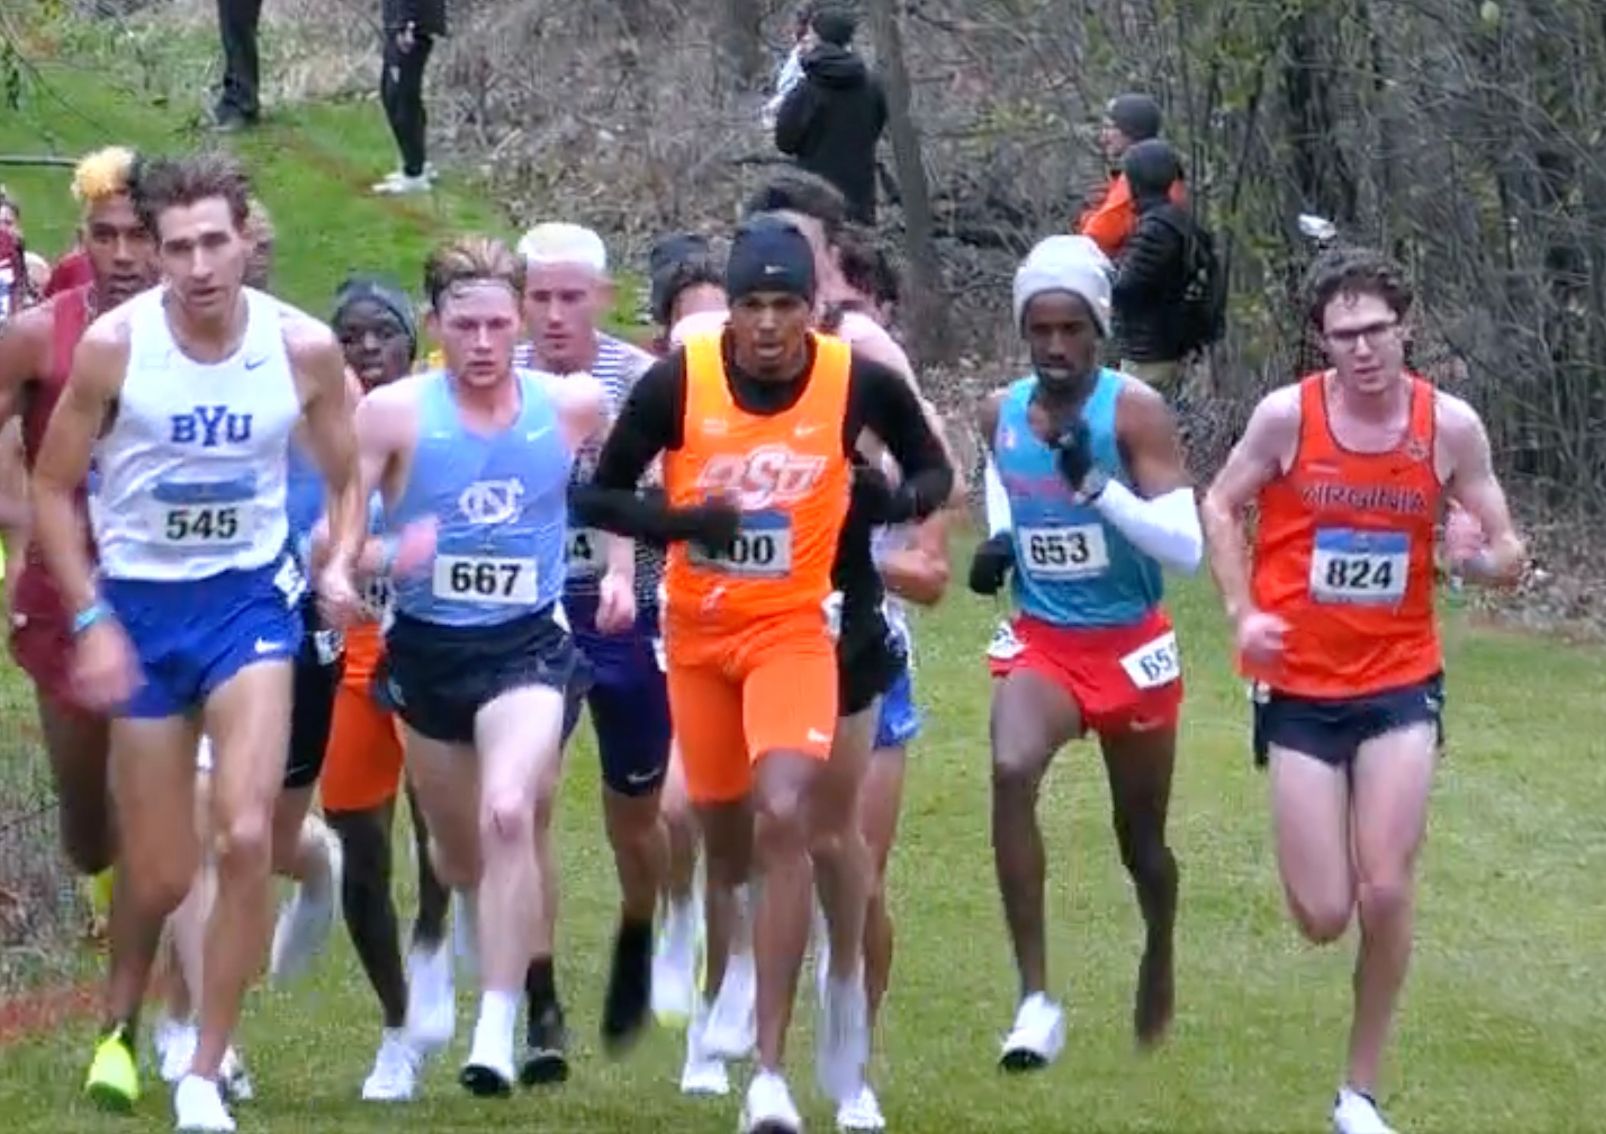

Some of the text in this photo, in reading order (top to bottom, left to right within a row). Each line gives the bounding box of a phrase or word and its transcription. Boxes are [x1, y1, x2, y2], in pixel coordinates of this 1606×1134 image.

[170, 405, 252, 446] BYU
[165, 508, 238, 540] 545
[708, 535, 775, 564] 00
[1030, 532, 1089, 564] 653
[451, 561, 523, 596] 667
[1325, 558, 1393, 589] 824
[1139, 644, 1177, 681] 65
